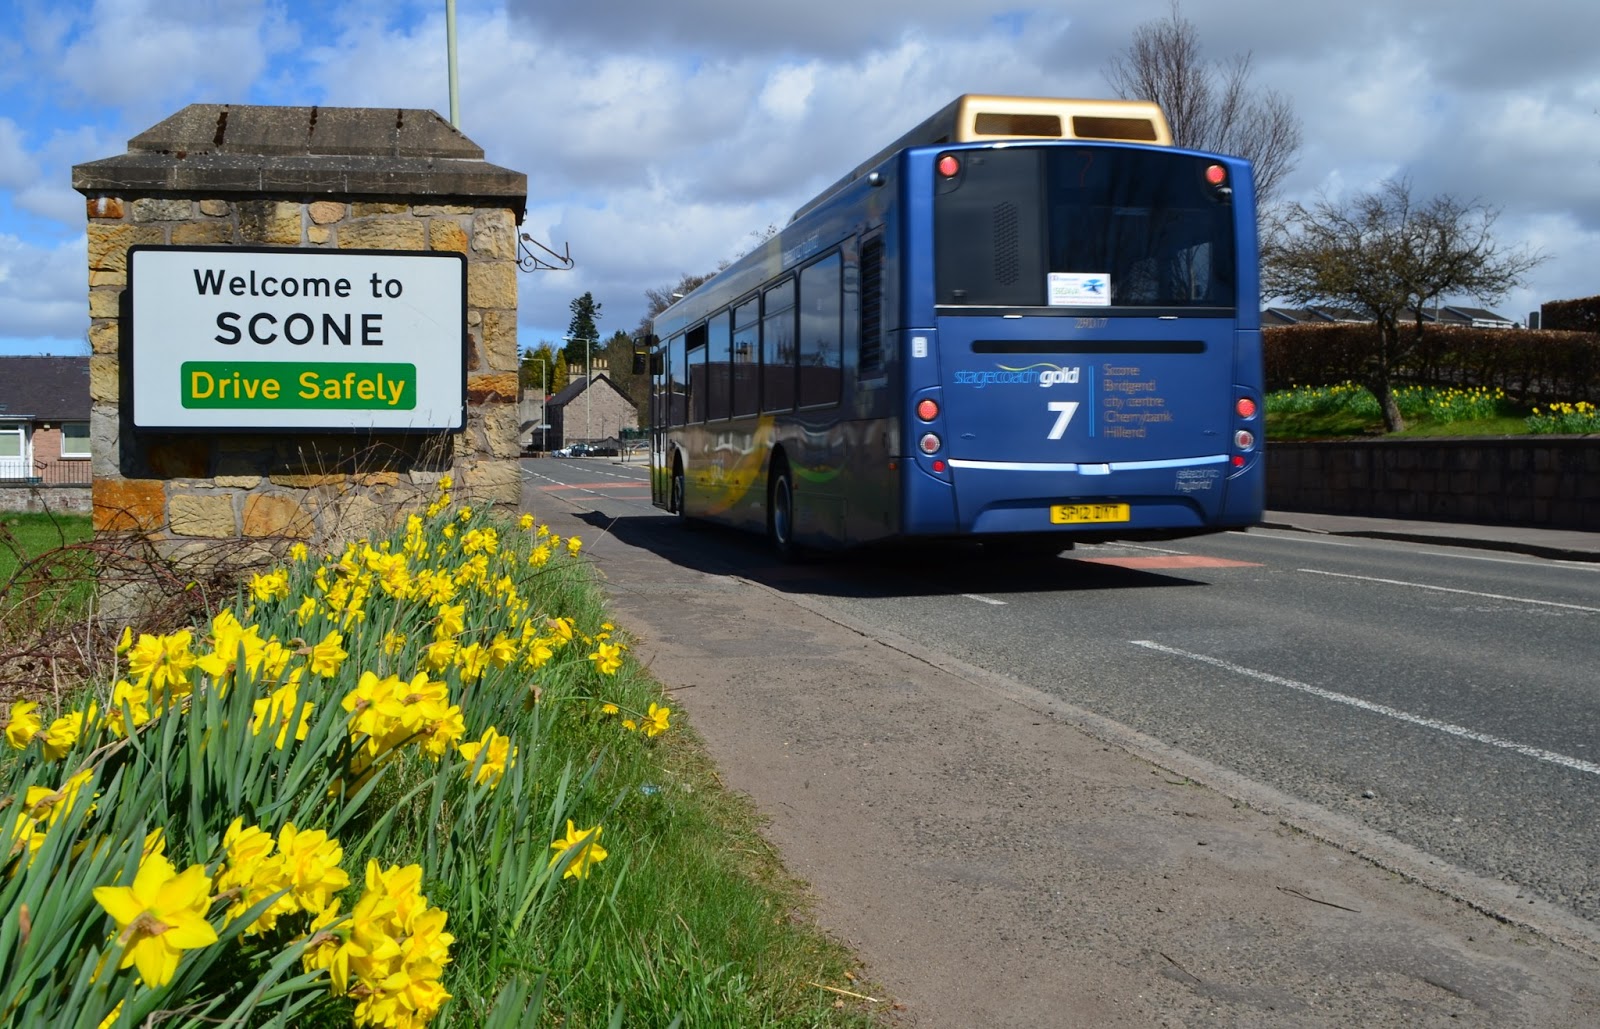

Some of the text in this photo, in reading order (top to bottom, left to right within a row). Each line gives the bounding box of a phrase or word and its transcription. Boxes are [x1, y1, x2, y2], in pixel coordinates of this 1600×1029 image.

[193, 268, 403, 298] Welcome to
[214, 311, 384, 346] SCONE
[1039, 367, 1080, 387] gold
[1103, 363, 1140, 375] Scone
[191, 371, 405, 405] Drive Safely
[1047, 401, 1080, 440] 7
